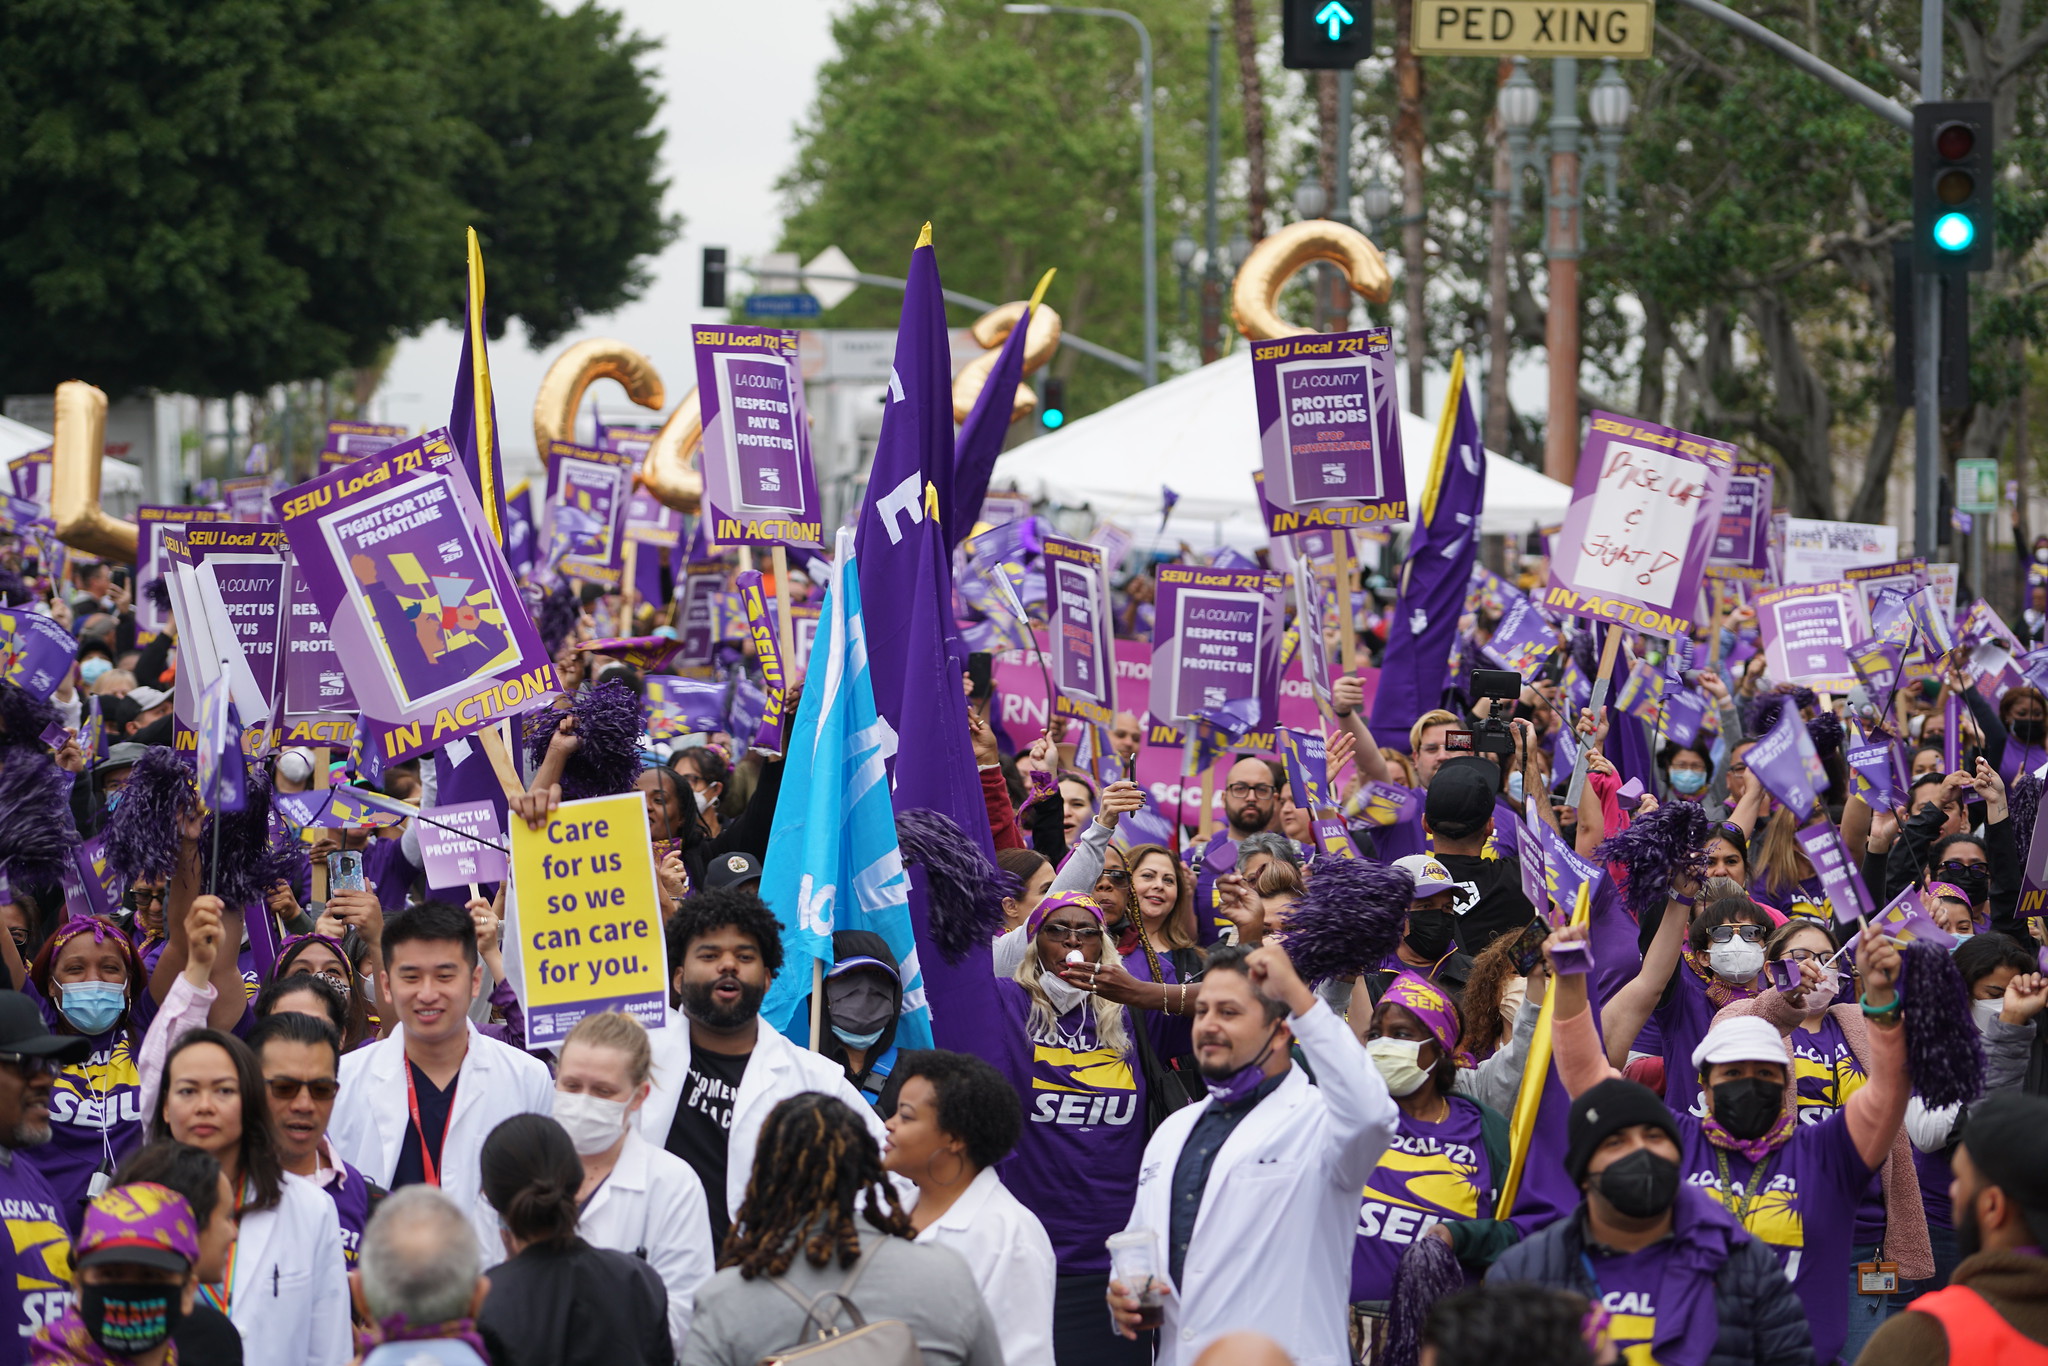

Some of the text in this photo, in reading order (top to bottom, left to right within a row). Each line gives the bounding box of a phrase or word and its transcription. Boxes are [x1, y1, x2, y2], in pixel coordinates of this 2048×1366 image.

[1436, 7, 1628, 45] PED XING
[696, 331, 779, 349] SEIU Local 721
[1255, 337, 1364, 361] SEIU Local 721
[735, 373, 784, 391] LA COUNTY
[1292, 373, 1360, 389] LA COUNTY
[735, 397, 788, 414] RESPECT US
[1292, 393, 1363, 411] PROTECT
[748, 416, 780, 431] PAY US
[1291, 409, 1368, 426] OUR JOBS
[737, 433, 794, 451] PROTECT US
[1316, 431, 1345, 441] STOP
[1591, 418, 1709, 456] SEIU Local 721
[1292, 441, 1371, 454] PRIVATIZATION
[431, 452, 454, 469] SEIU
[282, 448, 424, 521] SEIU Local 721
[337, 485, 448, 540] FIGHT FOR THE
[1272, 500, 1406, 532] IN ACTION!
[357, 505, 442, 549] FRONTLINE
[717, 520, 821, 542] IN ACTION!
[165, 535, 180, 554] SEIU
[188, 531, 280, 547] SEIU Local 721
[1044, 541, 1063, 556] SEIU
[1063, 545, 1080, 560] Local
[227, 579, 275, 592] COUNTY
[1160, 570, 1260, 588] SEIU Local 721
[1546, 587, 1573, 608] IN
[1759, 592, 1783, 606] SEIU
[1786, 587, 1815, 601] Local
[258, 604, 275, 616] US
[1190, 607, 1253, 623] LA COUNTY
[1798, 605, 1835, 617] COUNTY
[243, 623, 259, 635] US
[309, 622, 328, 634] PA
[1784, 617, 1839, 631] RESPECT US
[1186, 627, 1254, 643] RESPECT US
[1786, 636, 1843, 650] PROTECT US
[258, 642, 273, 655] US
[291, 640, 335, 653] PROTE
[1199, 643, 1238, 657] PAY US
[1183, 657, 1253, 674] PROTECT US
[751, 626, 784, 726] SEIU 721
[320, 686, 344, 697] SEIU
[1279, 680, 1313, 698] JOB
[384, 664, 554, 759] IN ACTION!
[1056, 695, 1113, 726] IN ACTION!
[175, 730, 199, 751] IN
[1150, 726, 1178, 743] IN
[420, 808, 492, 830] RESPECT US
[438, 825, 479, 841] PAY US
[547, 818, 610, 845] Care
[425, 840, 480, 858] PROTECT
[542, 852, 622, 880] for us
[1421, 865, 1451, 880] LAKERS
[547, 887, 625, 915] so we
[2020, 890, 2046, 912] IN
[532, 918, 649, 951] can care
[538, 955, 649, 986] for you.
[624, 1000, 663, 1013] #care4us
[49, 1090, 142, 1127] SEIU
[688, 1086, 733, 1129] BLAC
[1031, 1093, 1138, 1125] SEIU
[1390, 1134, 1477, 1165] OCAL 721
[339, 1228, 360, 1249] 21
[1602, 1291, 1656, 1314] CAL
